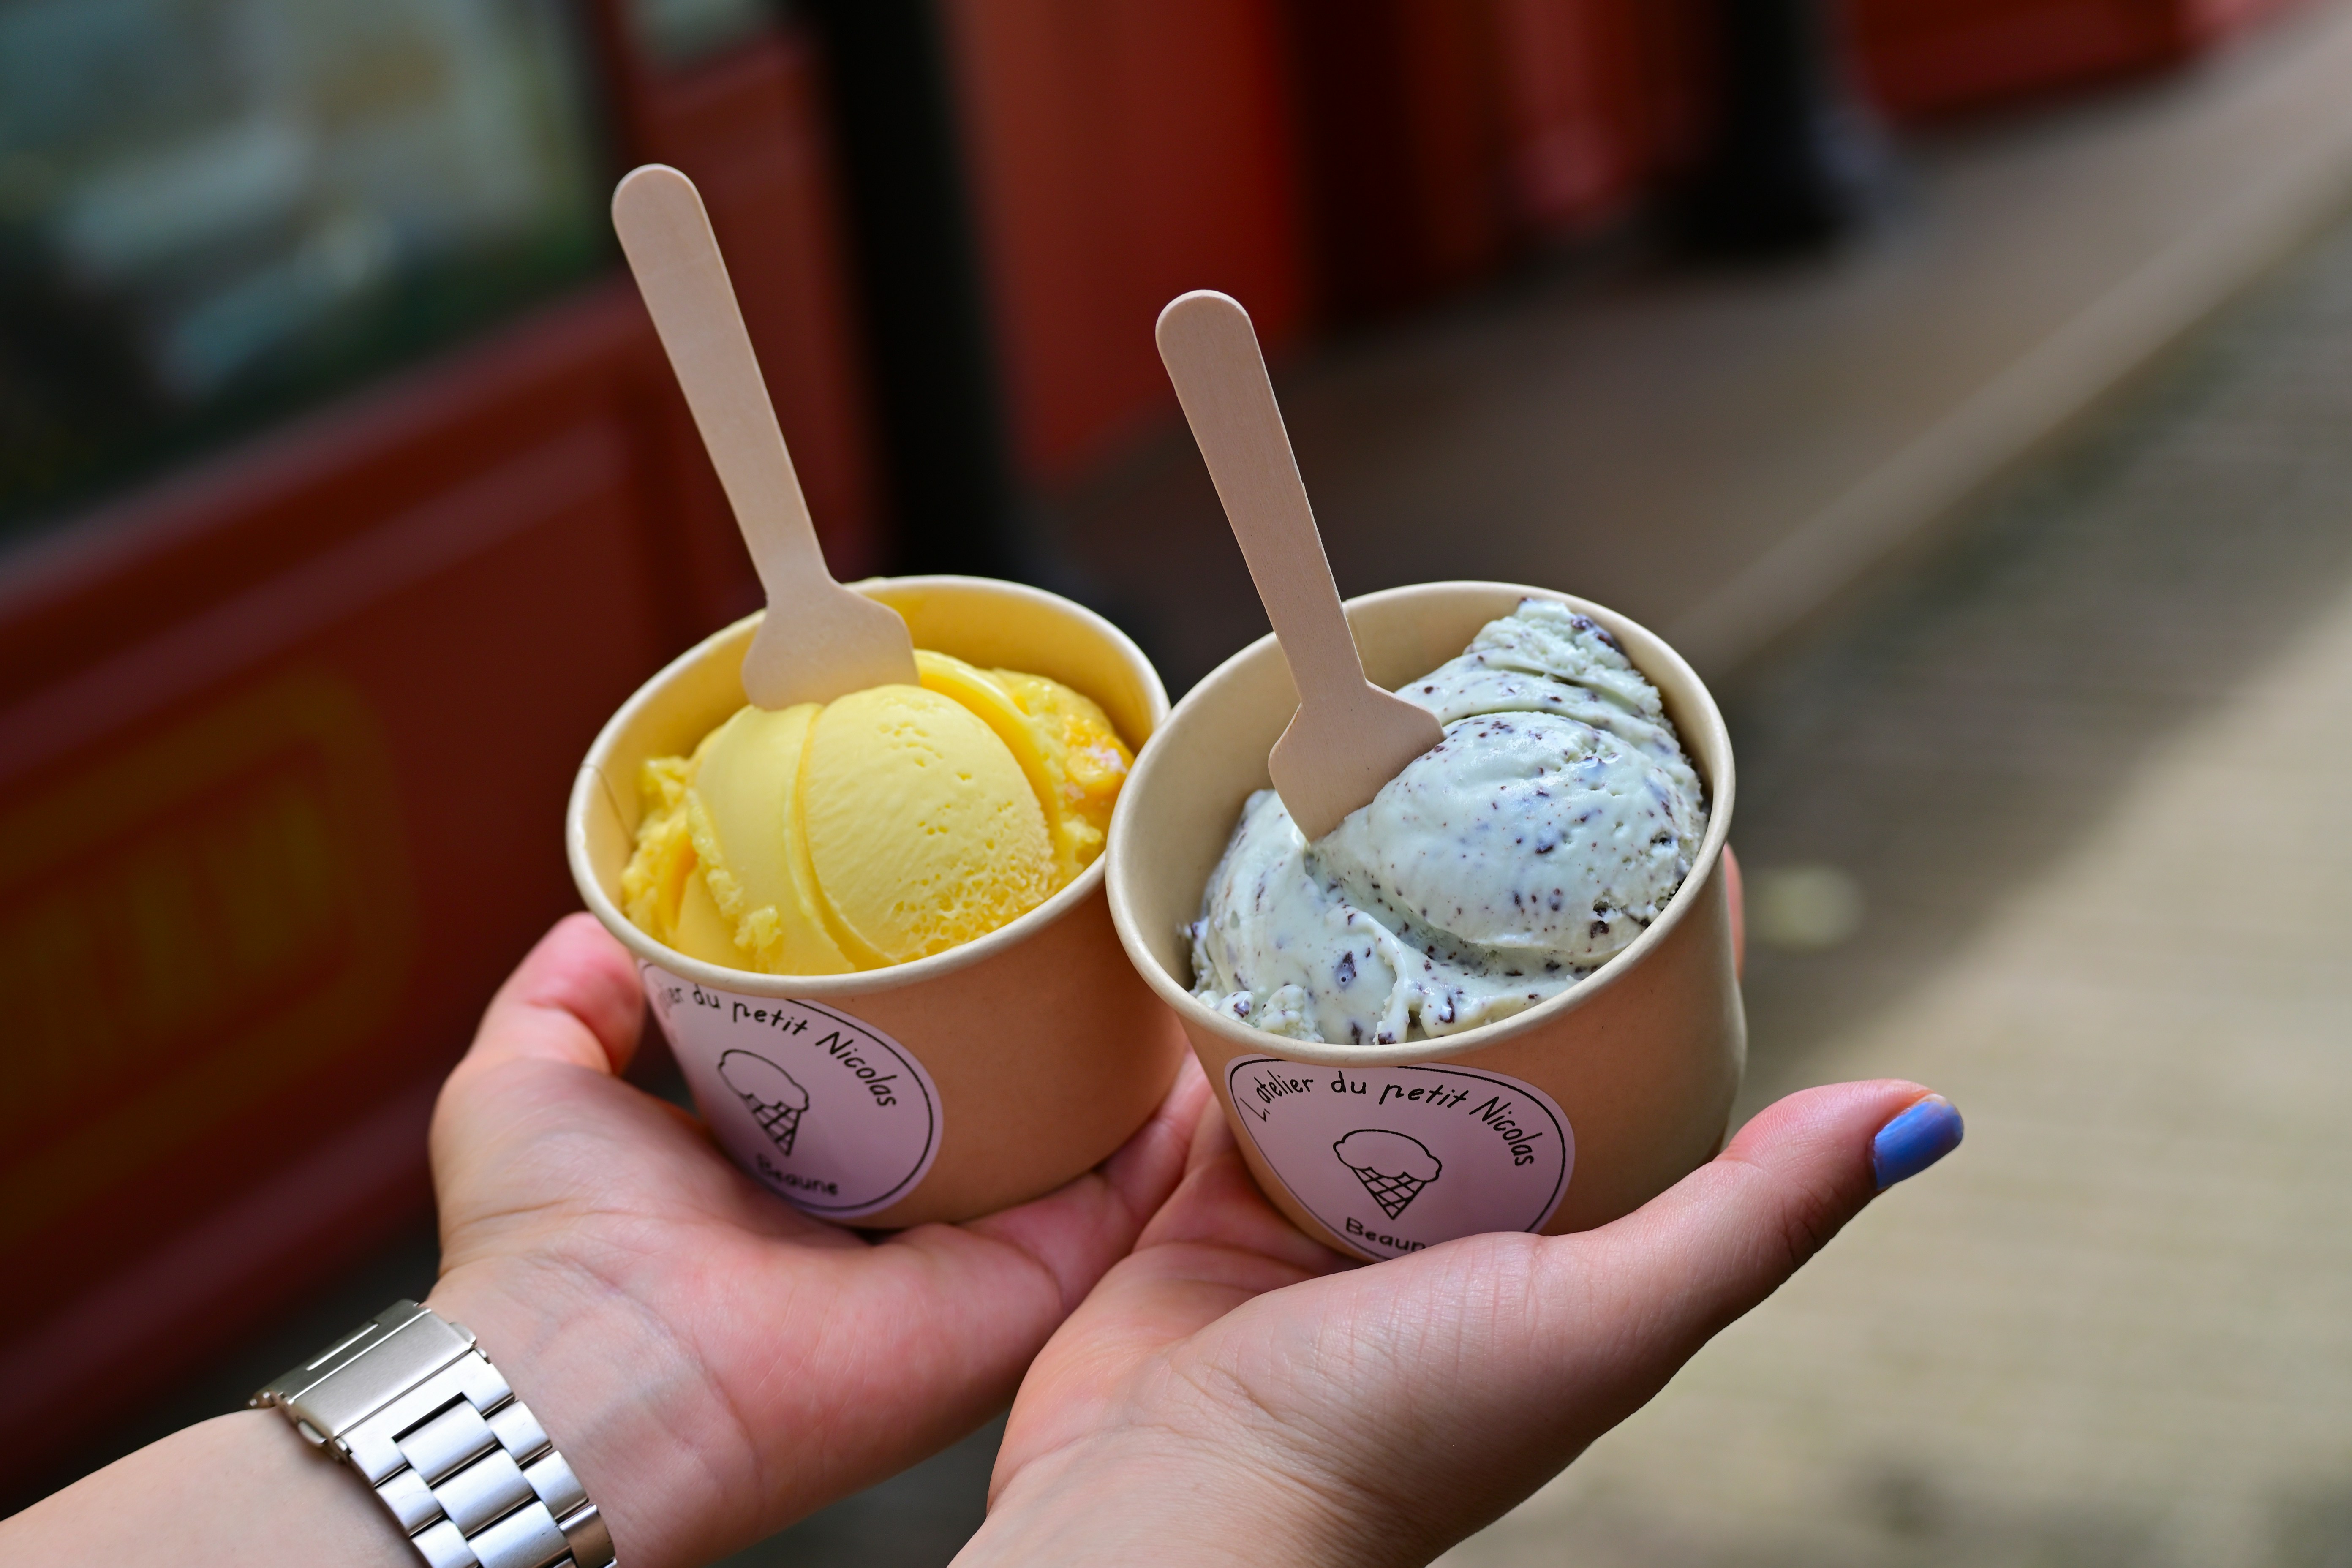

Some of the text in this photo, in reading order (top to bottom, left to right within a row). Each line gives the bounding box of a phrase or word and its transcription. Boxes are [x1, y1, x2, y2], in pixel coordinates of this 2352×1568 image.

[693, 983, 721, 1009] du
[732, 1000, 808, 1036] petit
[815, 1031, 897, 1107] Nicolas
[1331, 1070, 1367, 1094] du
[1379, 1084, 1469, 1108] petit
[1469, 1096, 1543, 1167] Nicolas
[1345, 1216, 1426, 1252] Beaun
